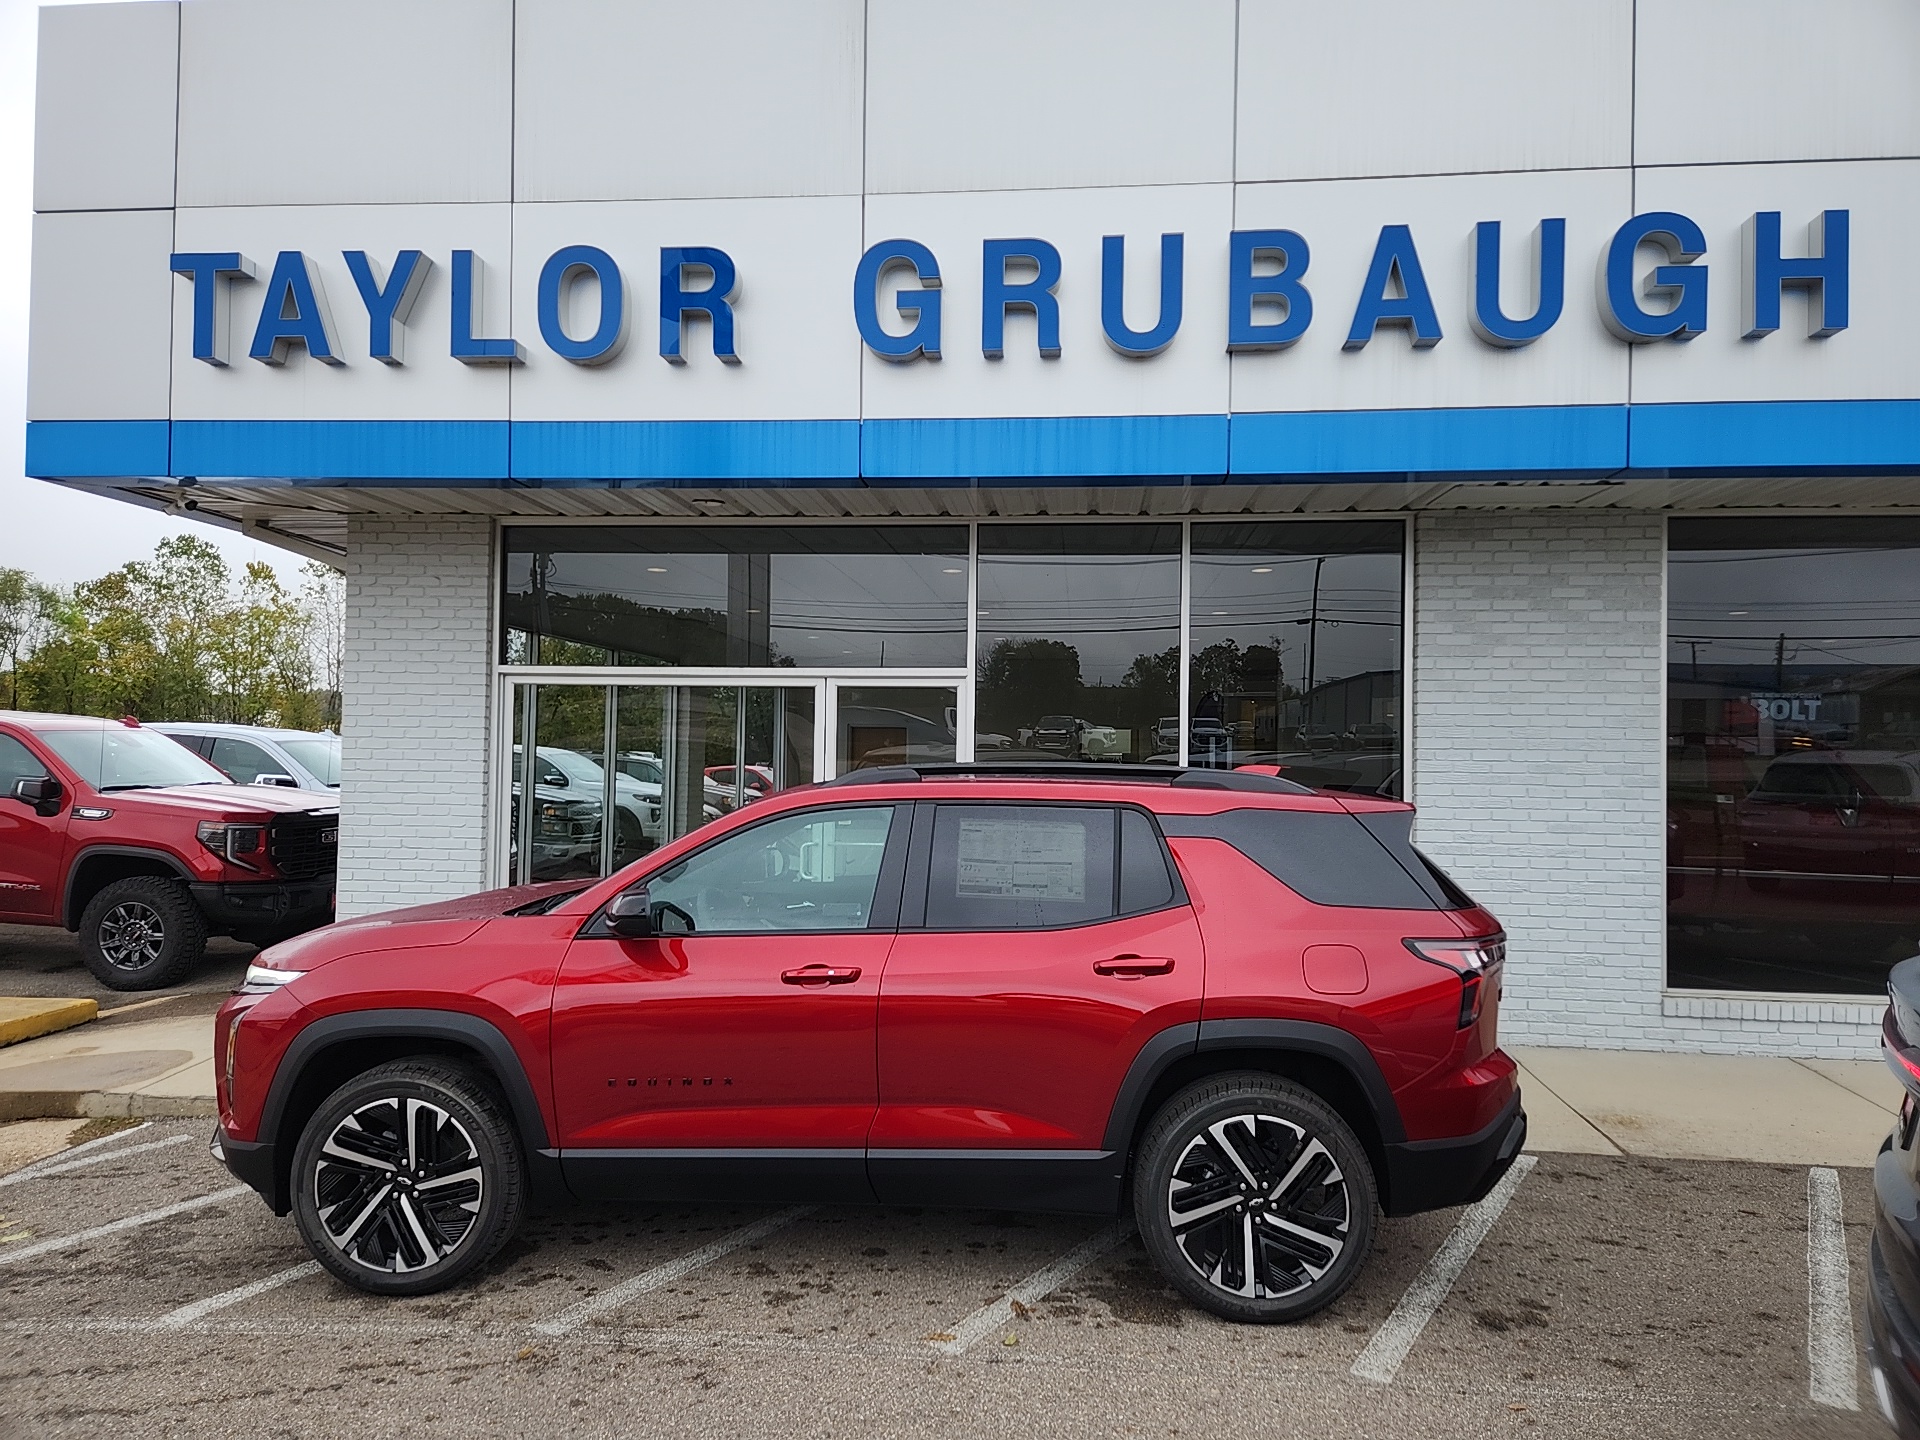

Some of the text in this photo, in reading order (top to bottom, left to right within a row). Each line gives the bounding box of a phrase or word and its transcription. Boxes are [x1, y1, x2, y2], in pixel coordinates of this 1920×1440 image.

[170, 209, 1850, 366] TAYLOR GRUBAUGH
[1751, 699, 1822, 721] BOLT
[607, 1077, 733, 1088] EQUINOX
